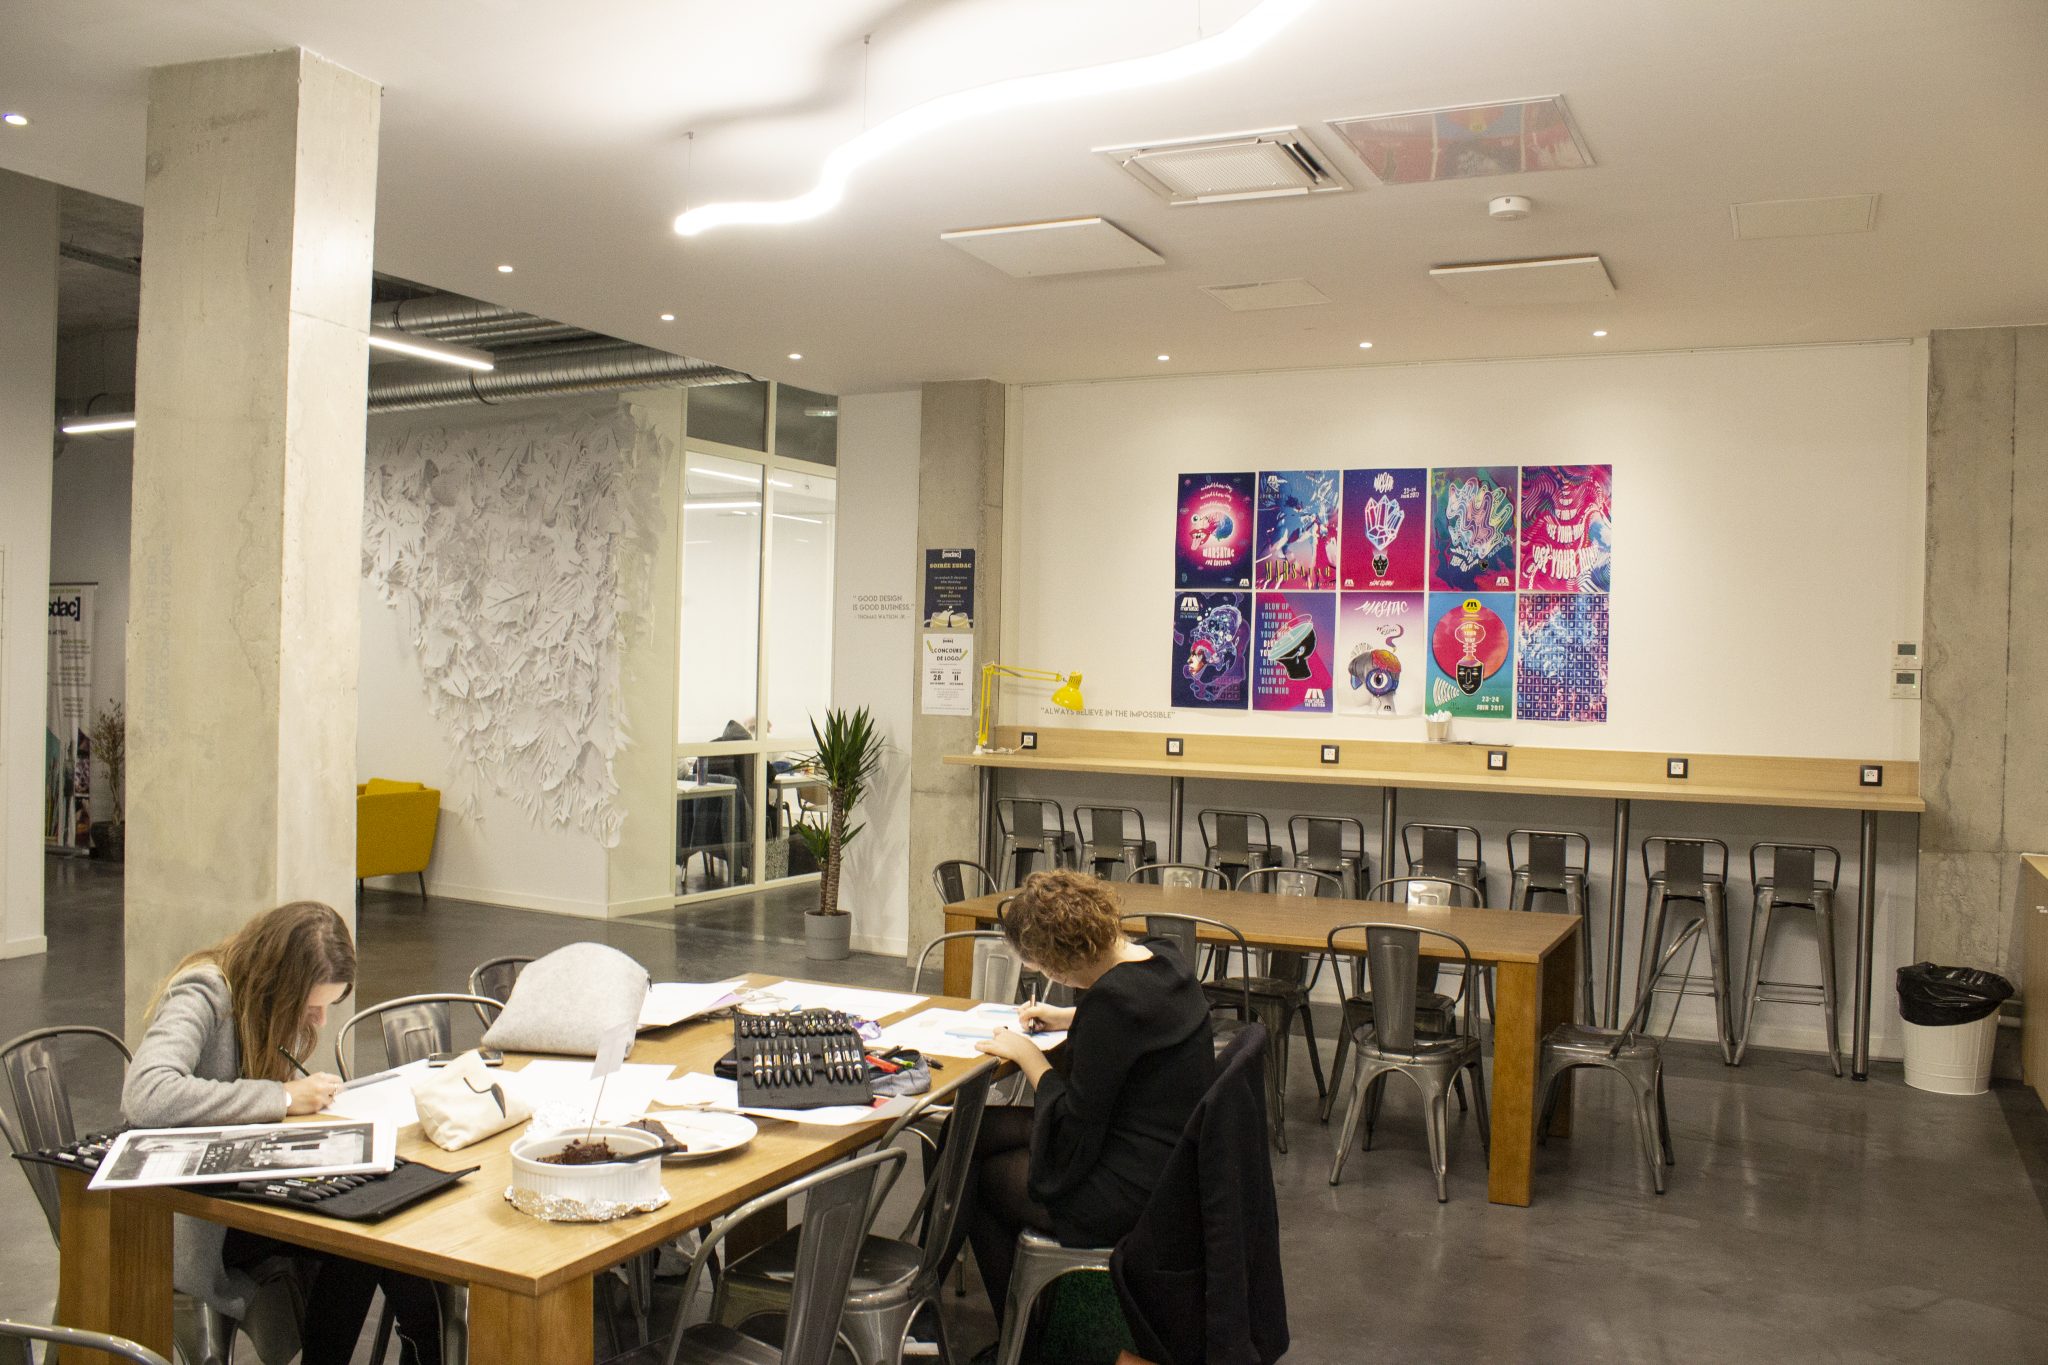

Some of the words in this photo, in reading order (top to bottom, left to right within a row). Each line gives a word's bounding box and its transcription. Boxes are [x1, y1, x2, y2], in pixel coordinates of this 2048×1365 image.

[1551, 549, 1577, 579] YOUR
[1261, 612, 1276, 620] YOUR
[1277, 612, 1292, 620] MIND
[1261, 677, 1277, 685] BLOW
[1278, 677, 1286, 685] UP
[1257, 686, 1273, 694] YOUR
[1274, 687, 1290, 695] MIND
